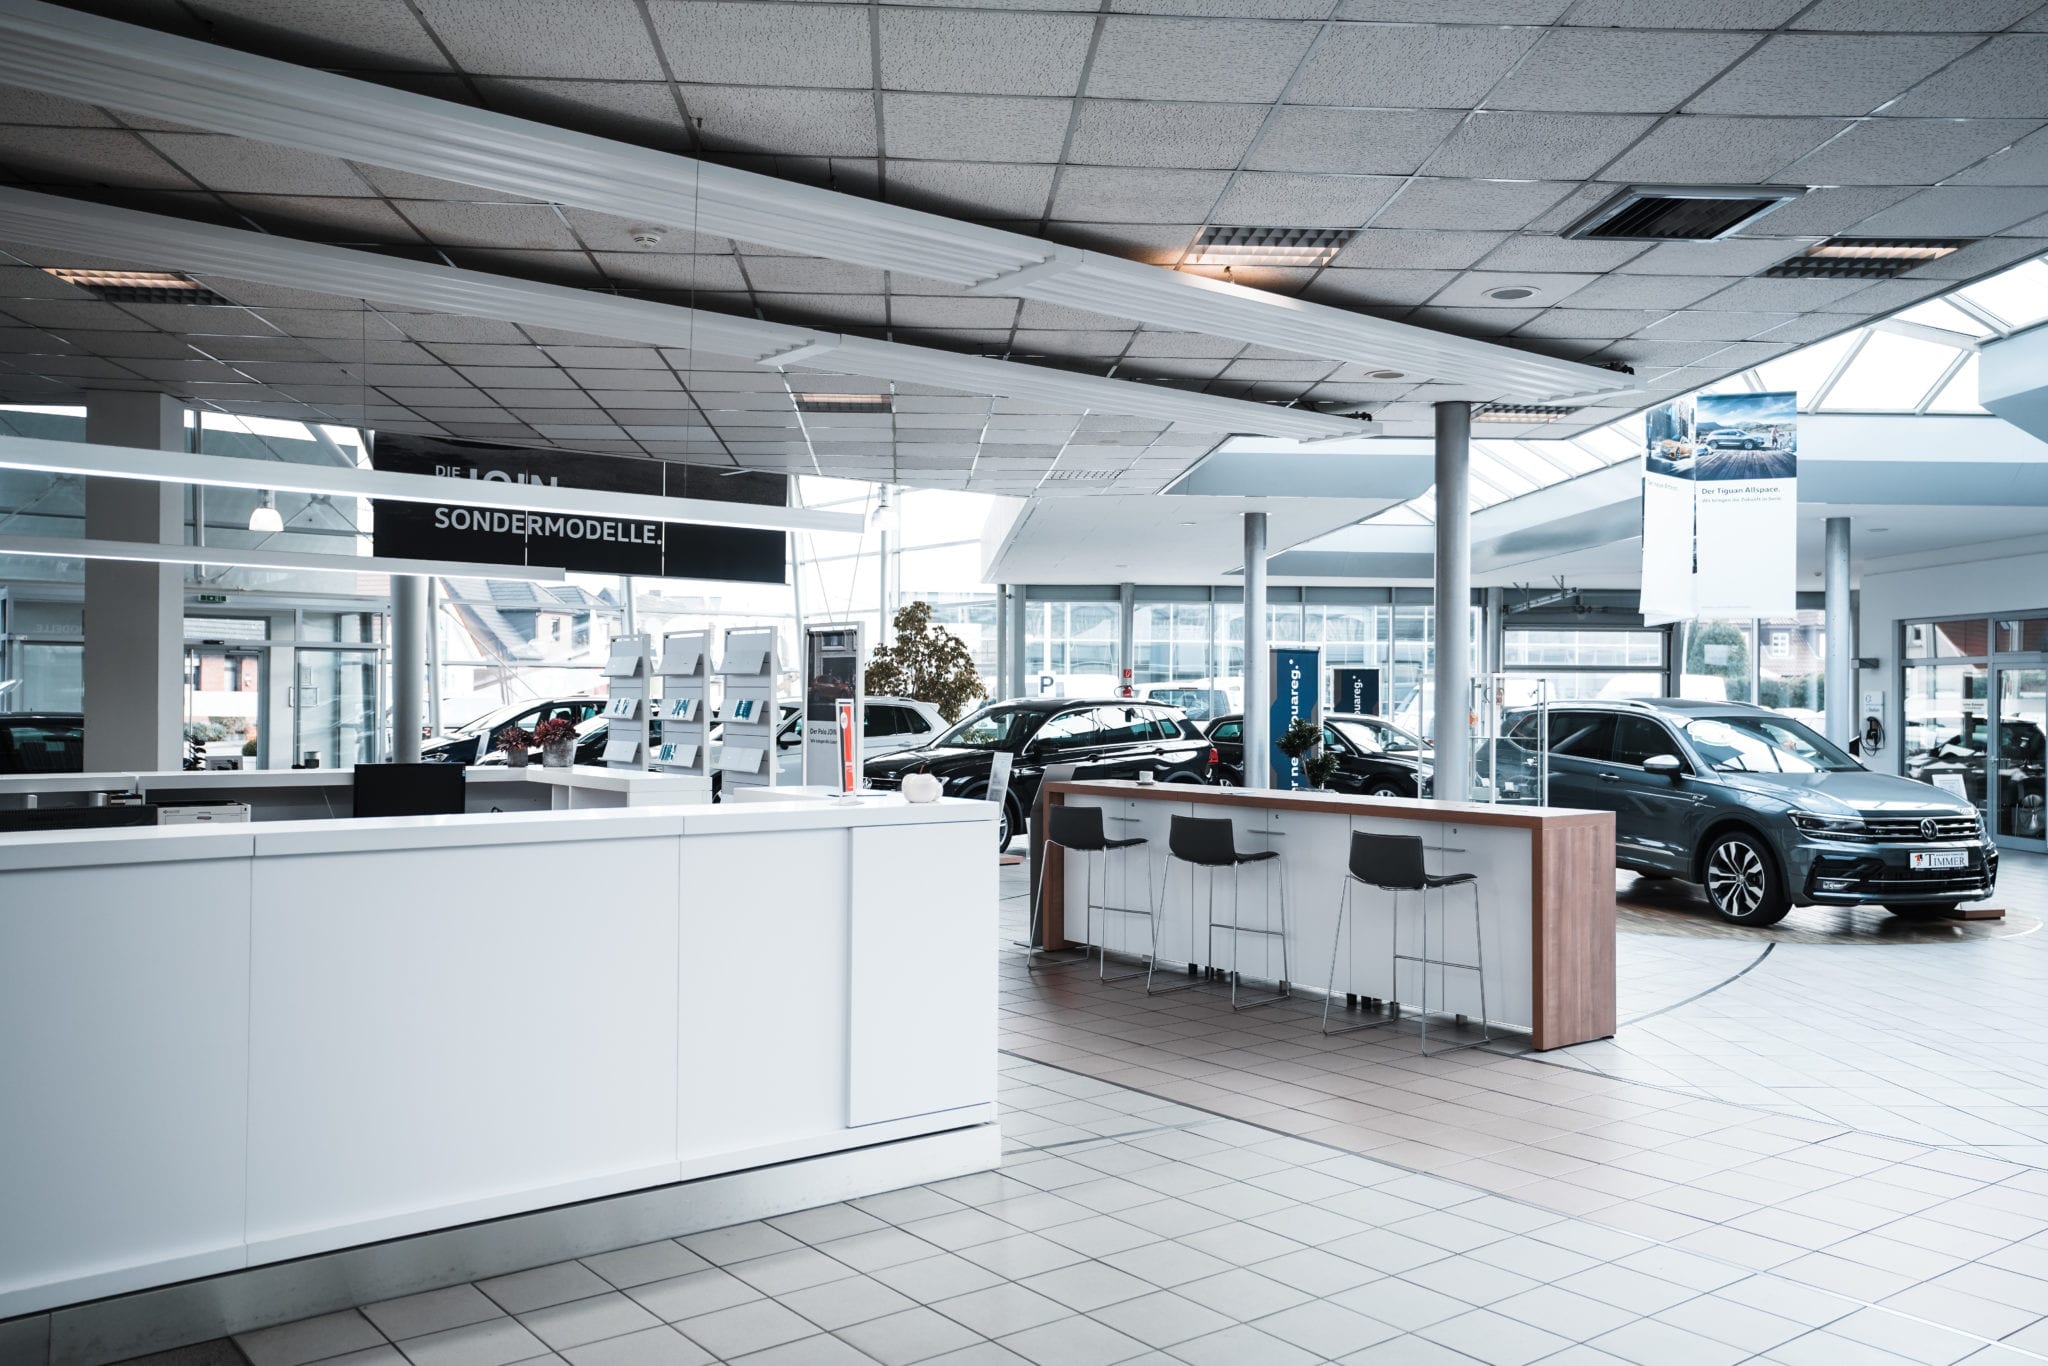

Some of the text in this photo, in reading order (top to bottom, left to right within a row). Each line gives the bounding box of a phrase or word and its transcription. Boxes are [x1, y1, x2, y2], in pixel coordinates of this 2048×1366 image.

[435, 465, 460, 478] DIE
[1717, 487, 1743, 496] Tiguan
[435, 507, 662, 545] SONDERMODELLE.
[1040, 676, 1054, 694] P
